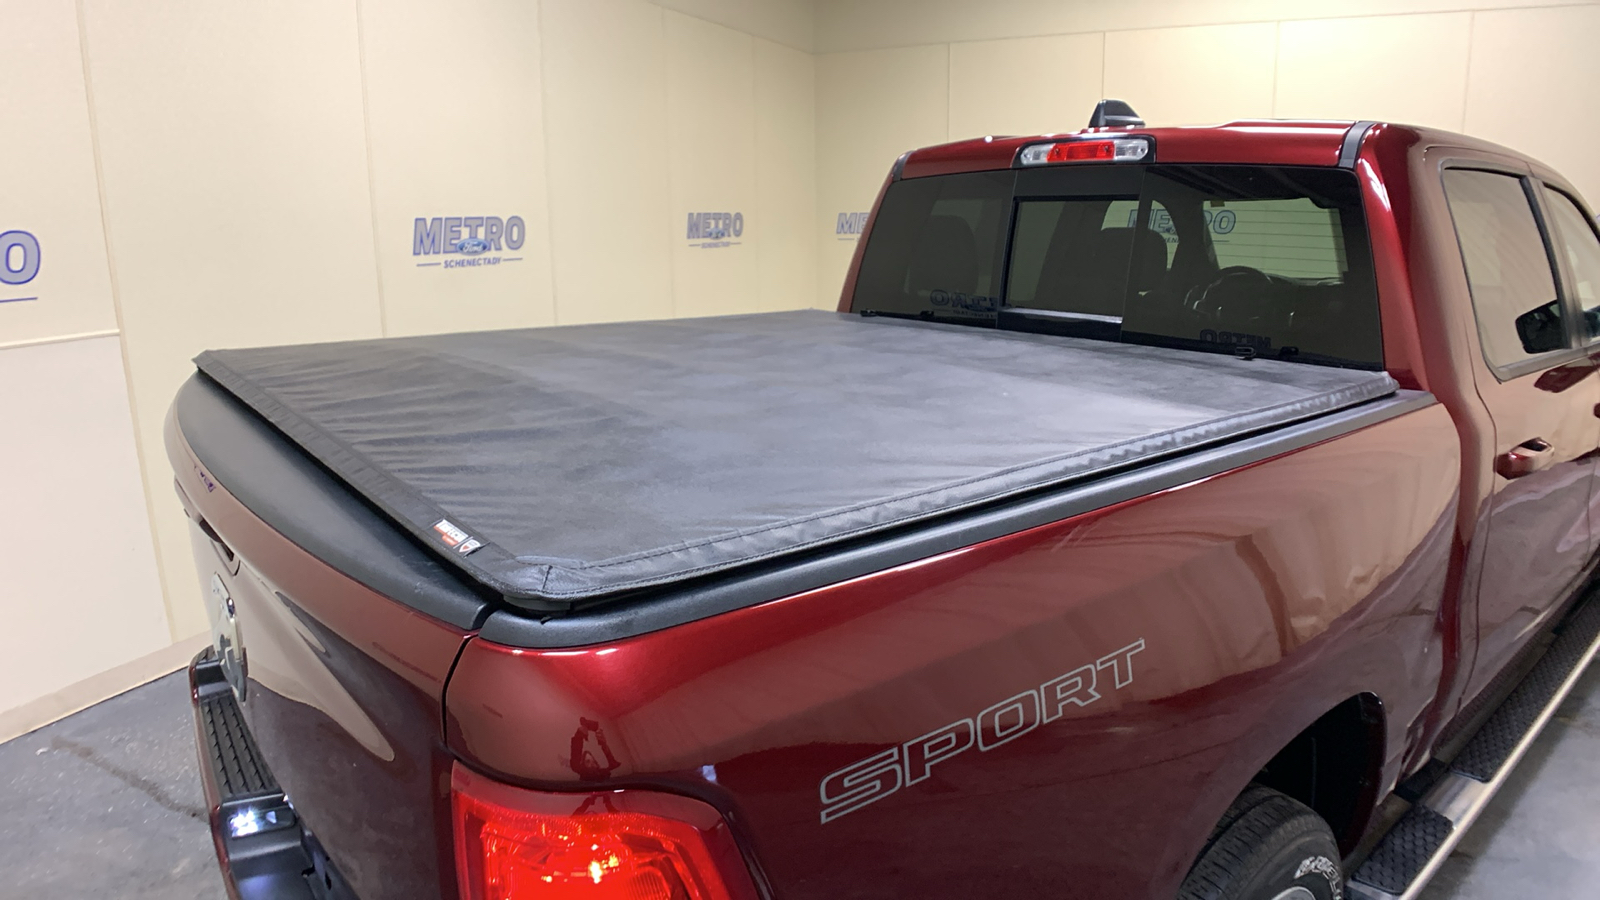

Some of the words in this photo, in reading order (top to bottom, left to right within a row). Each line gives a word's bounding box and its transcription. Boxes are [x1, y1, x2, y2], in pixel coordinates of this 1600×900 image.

[412, 215, 526, 256] METRO
[686, 212, 744, 240] METRO
[443, 256, 502, 269] SCHENECTADY
[820, 637, 1146, 825] SPORT
